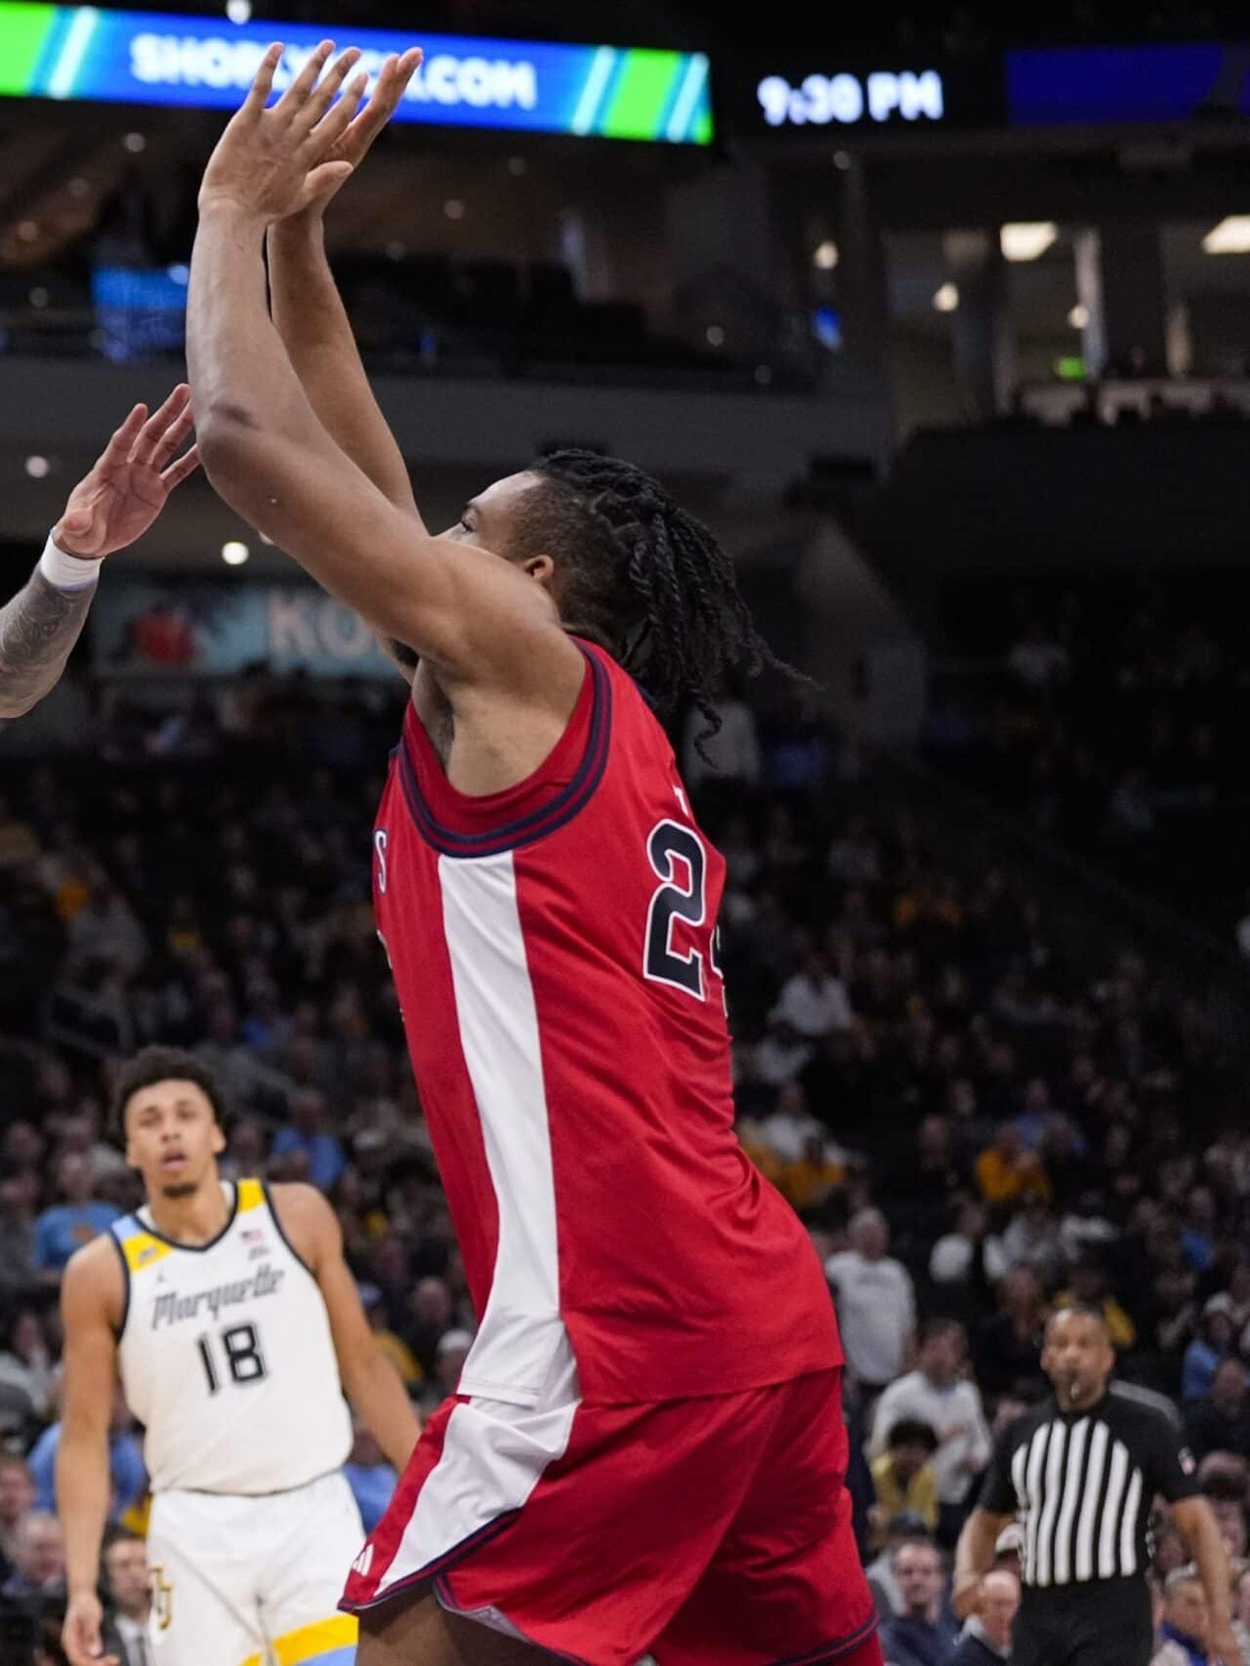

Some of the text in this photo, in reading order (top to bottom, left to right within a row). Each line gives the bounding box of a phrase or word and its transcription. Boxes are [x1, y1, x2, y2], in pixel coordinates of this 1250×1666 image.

[756, 70, 944, 126] 9:30 PM
[644, 818, 727, 1019] 2
[152, 1262, 285, 1331] Marquette
[195, 1320, 267, 1396] 18
